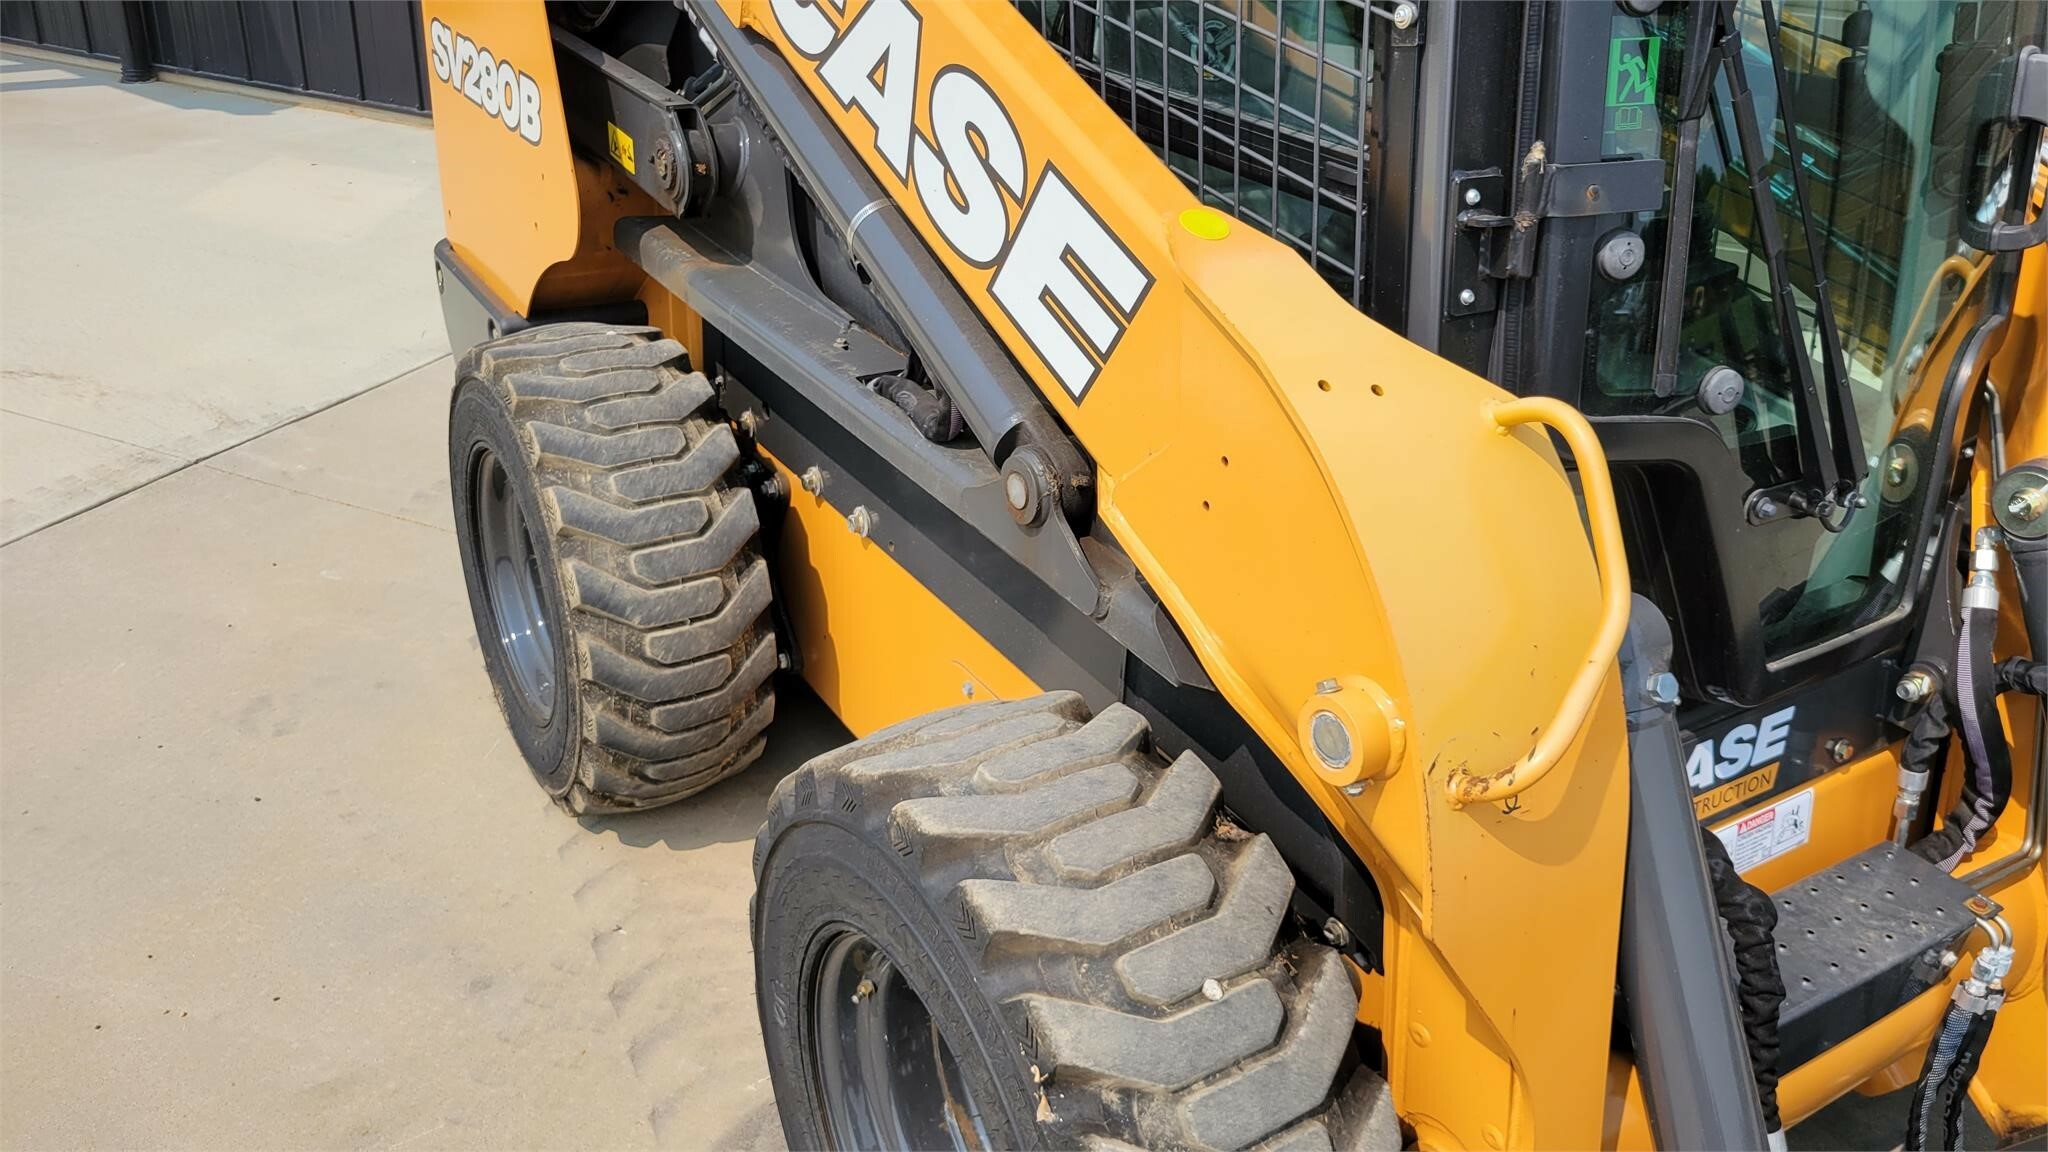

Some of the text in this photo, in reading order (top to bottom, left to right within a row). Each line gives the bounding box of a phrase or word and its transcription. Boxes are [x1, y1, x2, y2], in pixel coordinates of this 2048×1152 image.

[430, 17, 542, 147] SV280B
[1685, 705, 1796, 789] ASE
[1693, 769, 1774, 815] TRUCTION
